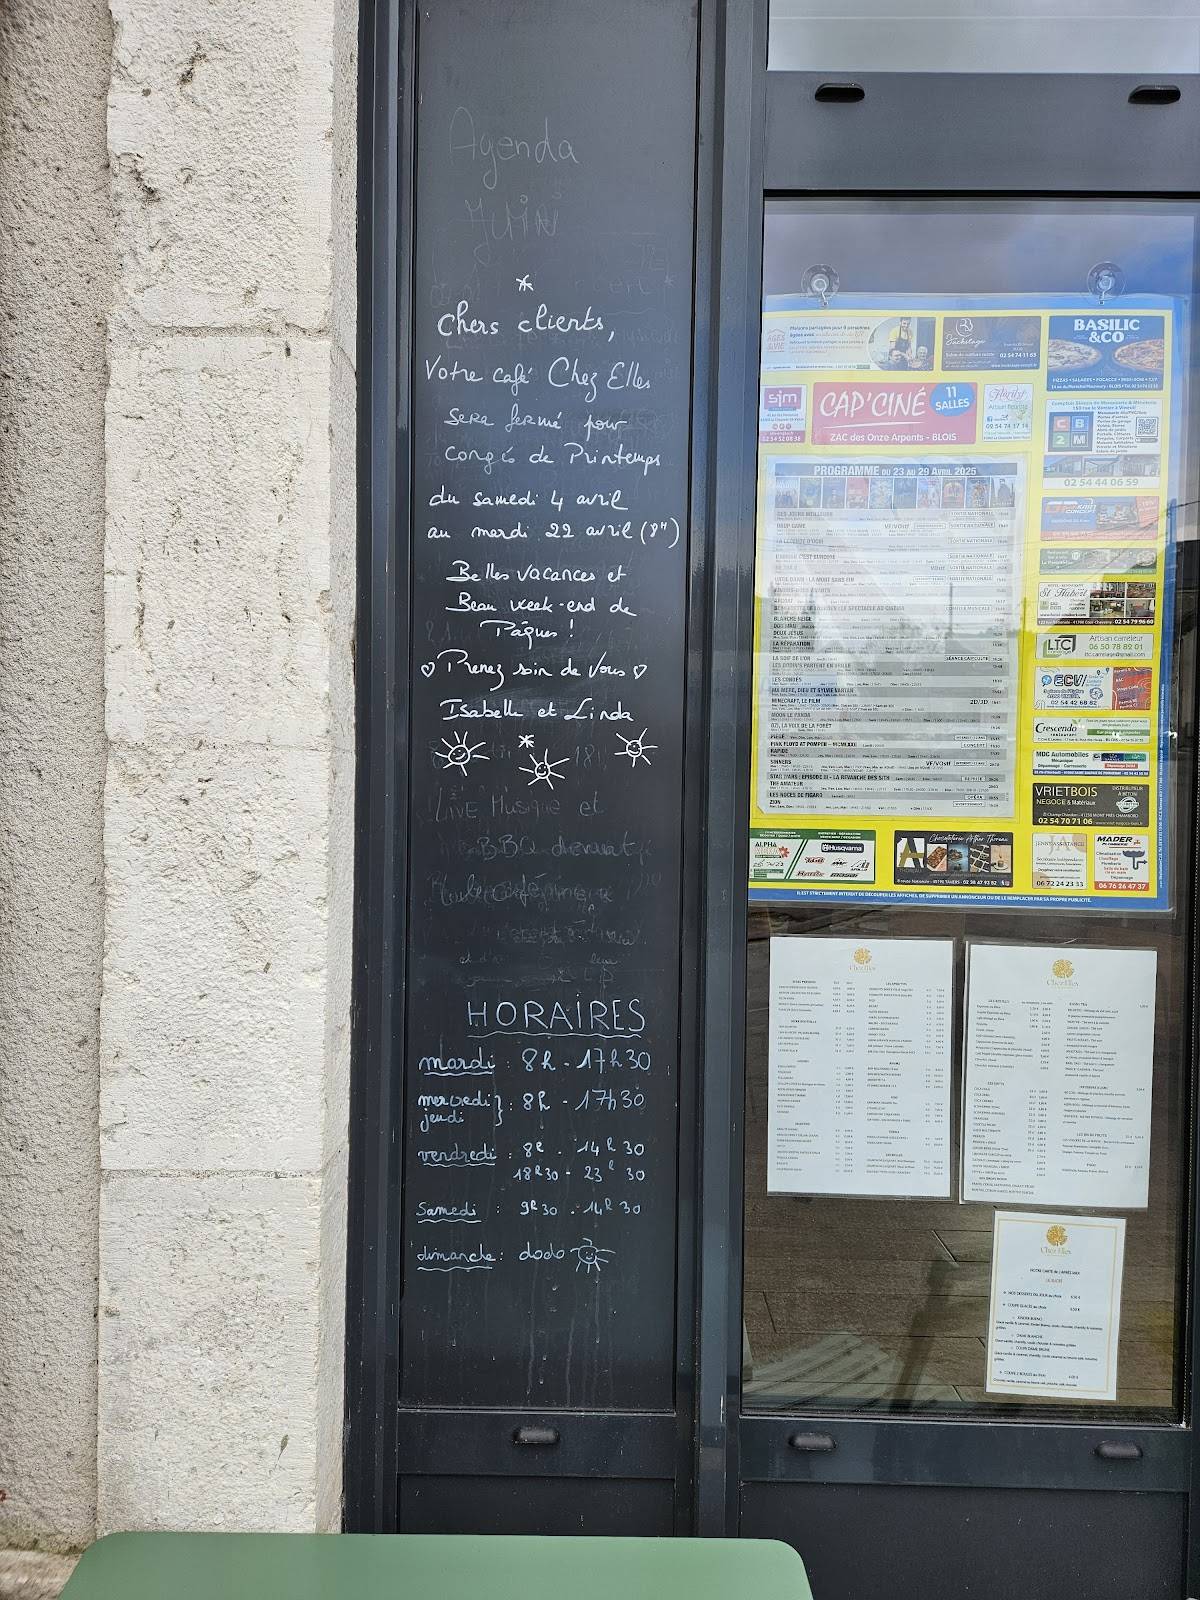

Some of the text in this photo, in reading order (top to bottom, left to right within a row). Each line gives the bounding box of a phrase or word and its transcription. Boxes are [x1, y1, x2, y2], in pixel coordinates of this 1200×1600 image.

[449, 107, 579, 189] Agenda
[438, 300, 615, 342] Chers clients,
[1074, 319, 1141, 331] BASILIC
[1088, 331, 1125, 343] &CO
[426, 355, 483, 383] Votre
[549, 357, 597, 403] Chez
[607, 361, 651, 390] Elles
[820, 387, 928, 419] CAP'CINÉ
[946, 386, 957, 398] 11
[936, 398, 970, 411] SALLES
[504, 403, 563, 433] fermé
[582, 413, 629, 442] pour
[829, 433, 957, 445] ZAC des Onze Arpents BLOIS
[529, 446, 555, 464] de
[564, 442, 661, 477] Printemps
[813, 465, 880, 477] PROGRAMME
[893, 466, 905, 476] 23
[918, 466, 930, 476] 29
[954, 465, 977, 476] 2025
[1064, 478, 1138, 487] 02 54 44 06 59
[429, 485, 629, 512] du samedi 4 avril
[427, 526, 451, 538] au
[471, 522, 528, 541] mardi
[545, 522, 576, 539] 22
[586, 521, 633, 539] avril
[445, 560, 628, 583] Belles vacances et
[1053, 587, 1087, 598] Hubert
[445, 592, 638, 617] Beau week-end de
[480, 619, 558, 651] Pâques
[1047, 639, 1072, 651] LTC
[437, 648, 505, 692] Prenez
[513, 662, 553, 679] soin
[560, 658, 582, 677] de
[439, 697, 635, 722] Isabelle et Linda
[1035, 723, 1077, 734] Crescendo
[1035, 786, 1098, 797] VRIETBOIS
[1038, 817, 1093, 825] 02 54 70 71 06
[829, 844, 863, 852] Husqvarna
[466, 993, 646, 1033] HORAIRES
[418, 1046, 497, 1070] mardi
[418, 1107, 466, 1133] jeudi
[417, 1142, 498, 1163] vendredi
[416, 1241, 566, 1264] dimanche dodo
